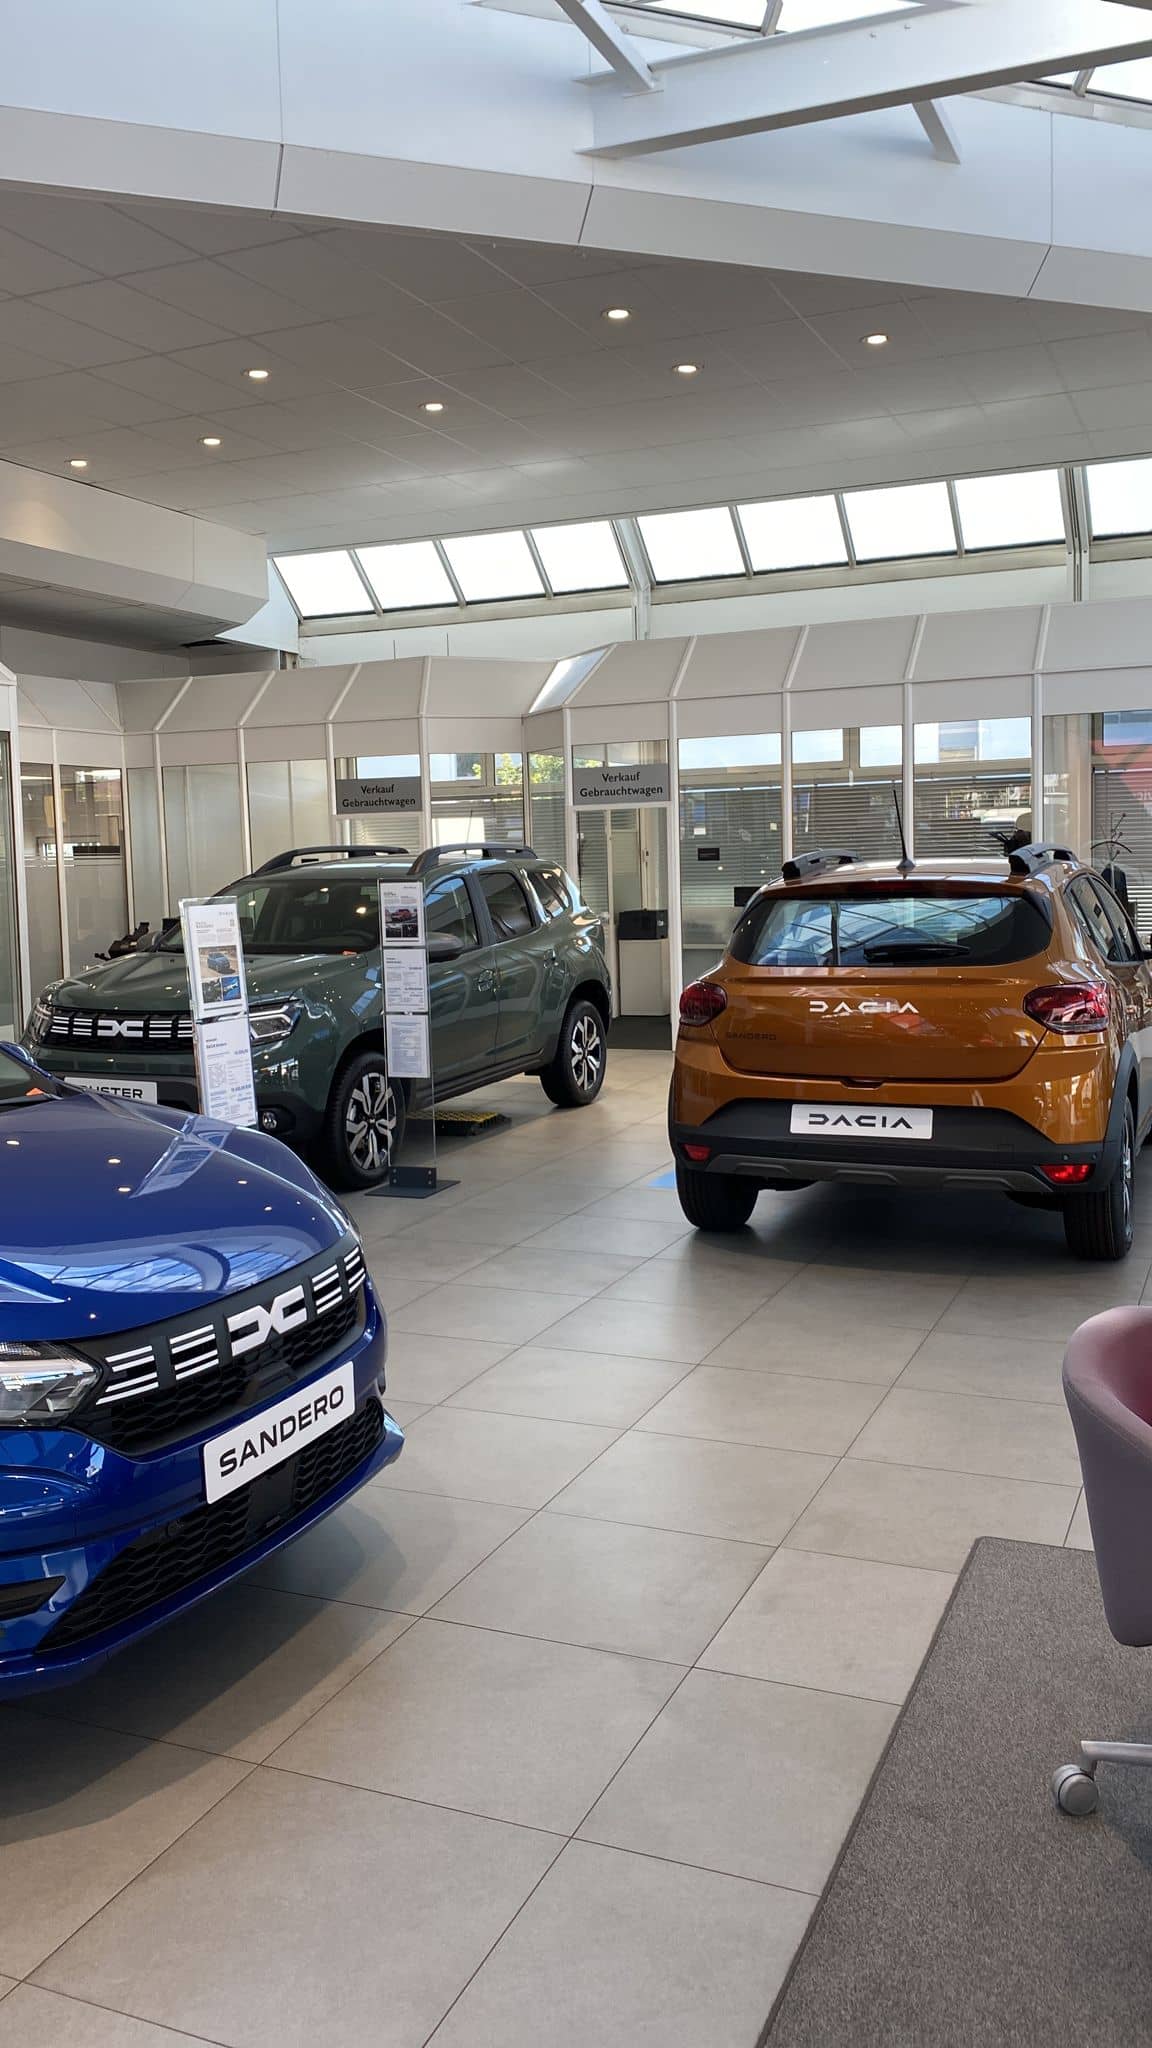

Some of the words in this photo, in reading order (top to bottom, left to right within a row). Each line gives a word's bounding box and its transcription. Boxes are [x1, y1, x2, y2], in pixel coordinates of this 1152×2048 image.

[601, 771, 641, 782] Verkauf
[360, 783, 395, 795] Verkauf
[579, 785, 663, 797] Gebrauchtwagen
[342, 797, 416, 808] Gebrauchtwagen
[809, 1000, 920, 1014] DACIA
[81, 1085, 144, 1099] STER
[808, 1112, 913, 1130] DACIA
[219, 1385, 344, 1478] SANDERO
